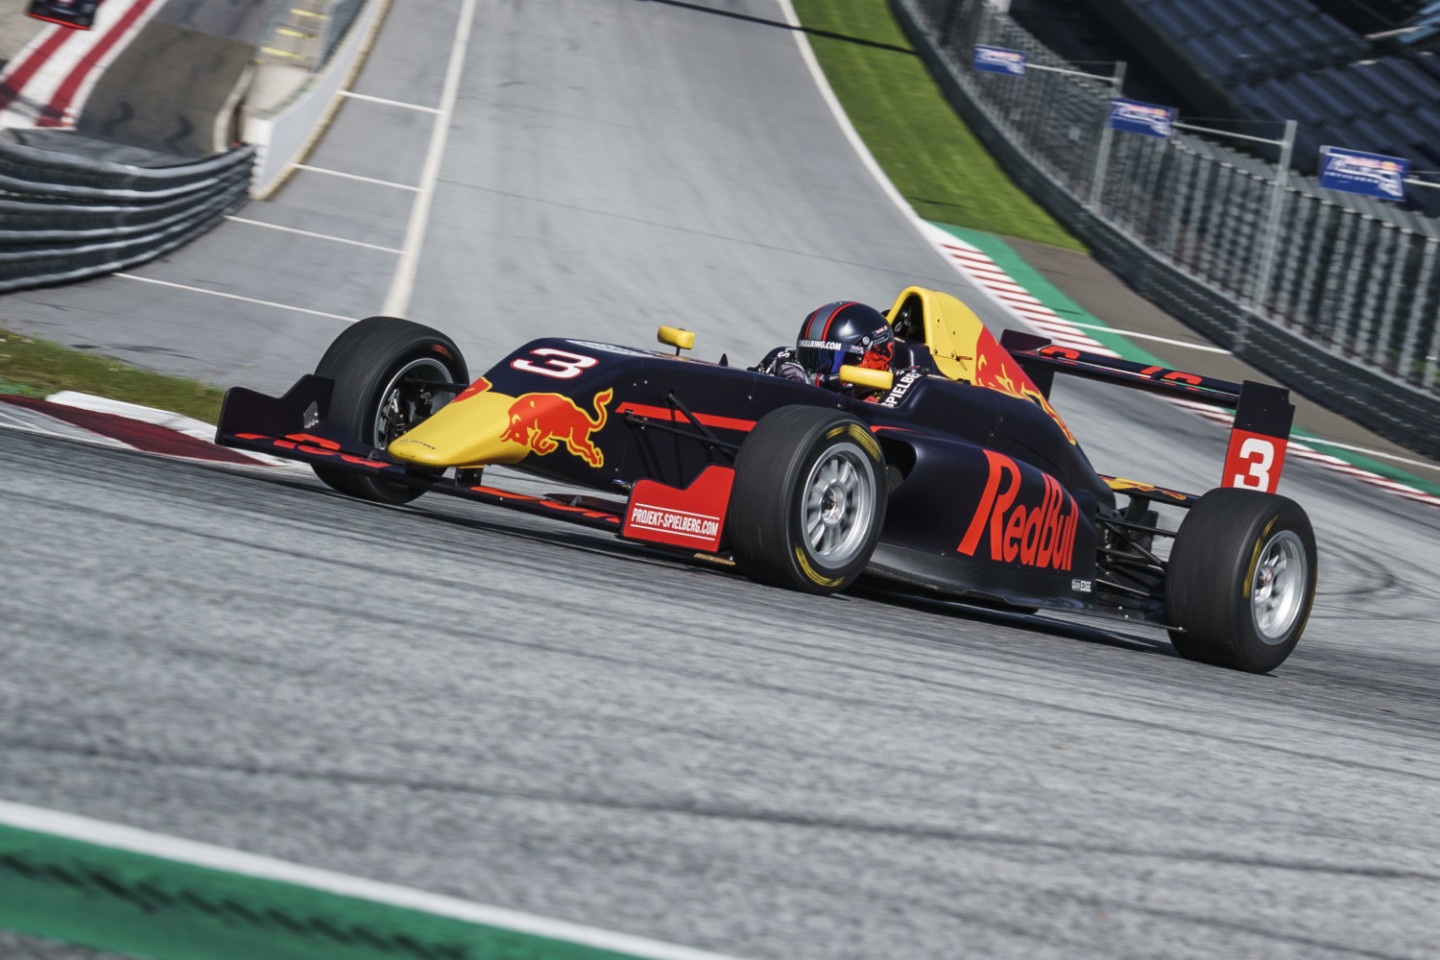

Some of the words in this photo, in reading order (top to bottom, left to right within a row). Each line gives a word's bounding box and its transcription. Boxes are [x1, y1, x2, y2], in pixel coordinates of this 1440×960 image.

[510, 347, 600, 380] 3
[1233, 437, 1275, 494] 3
[631, 508, 720, 537] PROJEKT-SPIELBERG.COM
